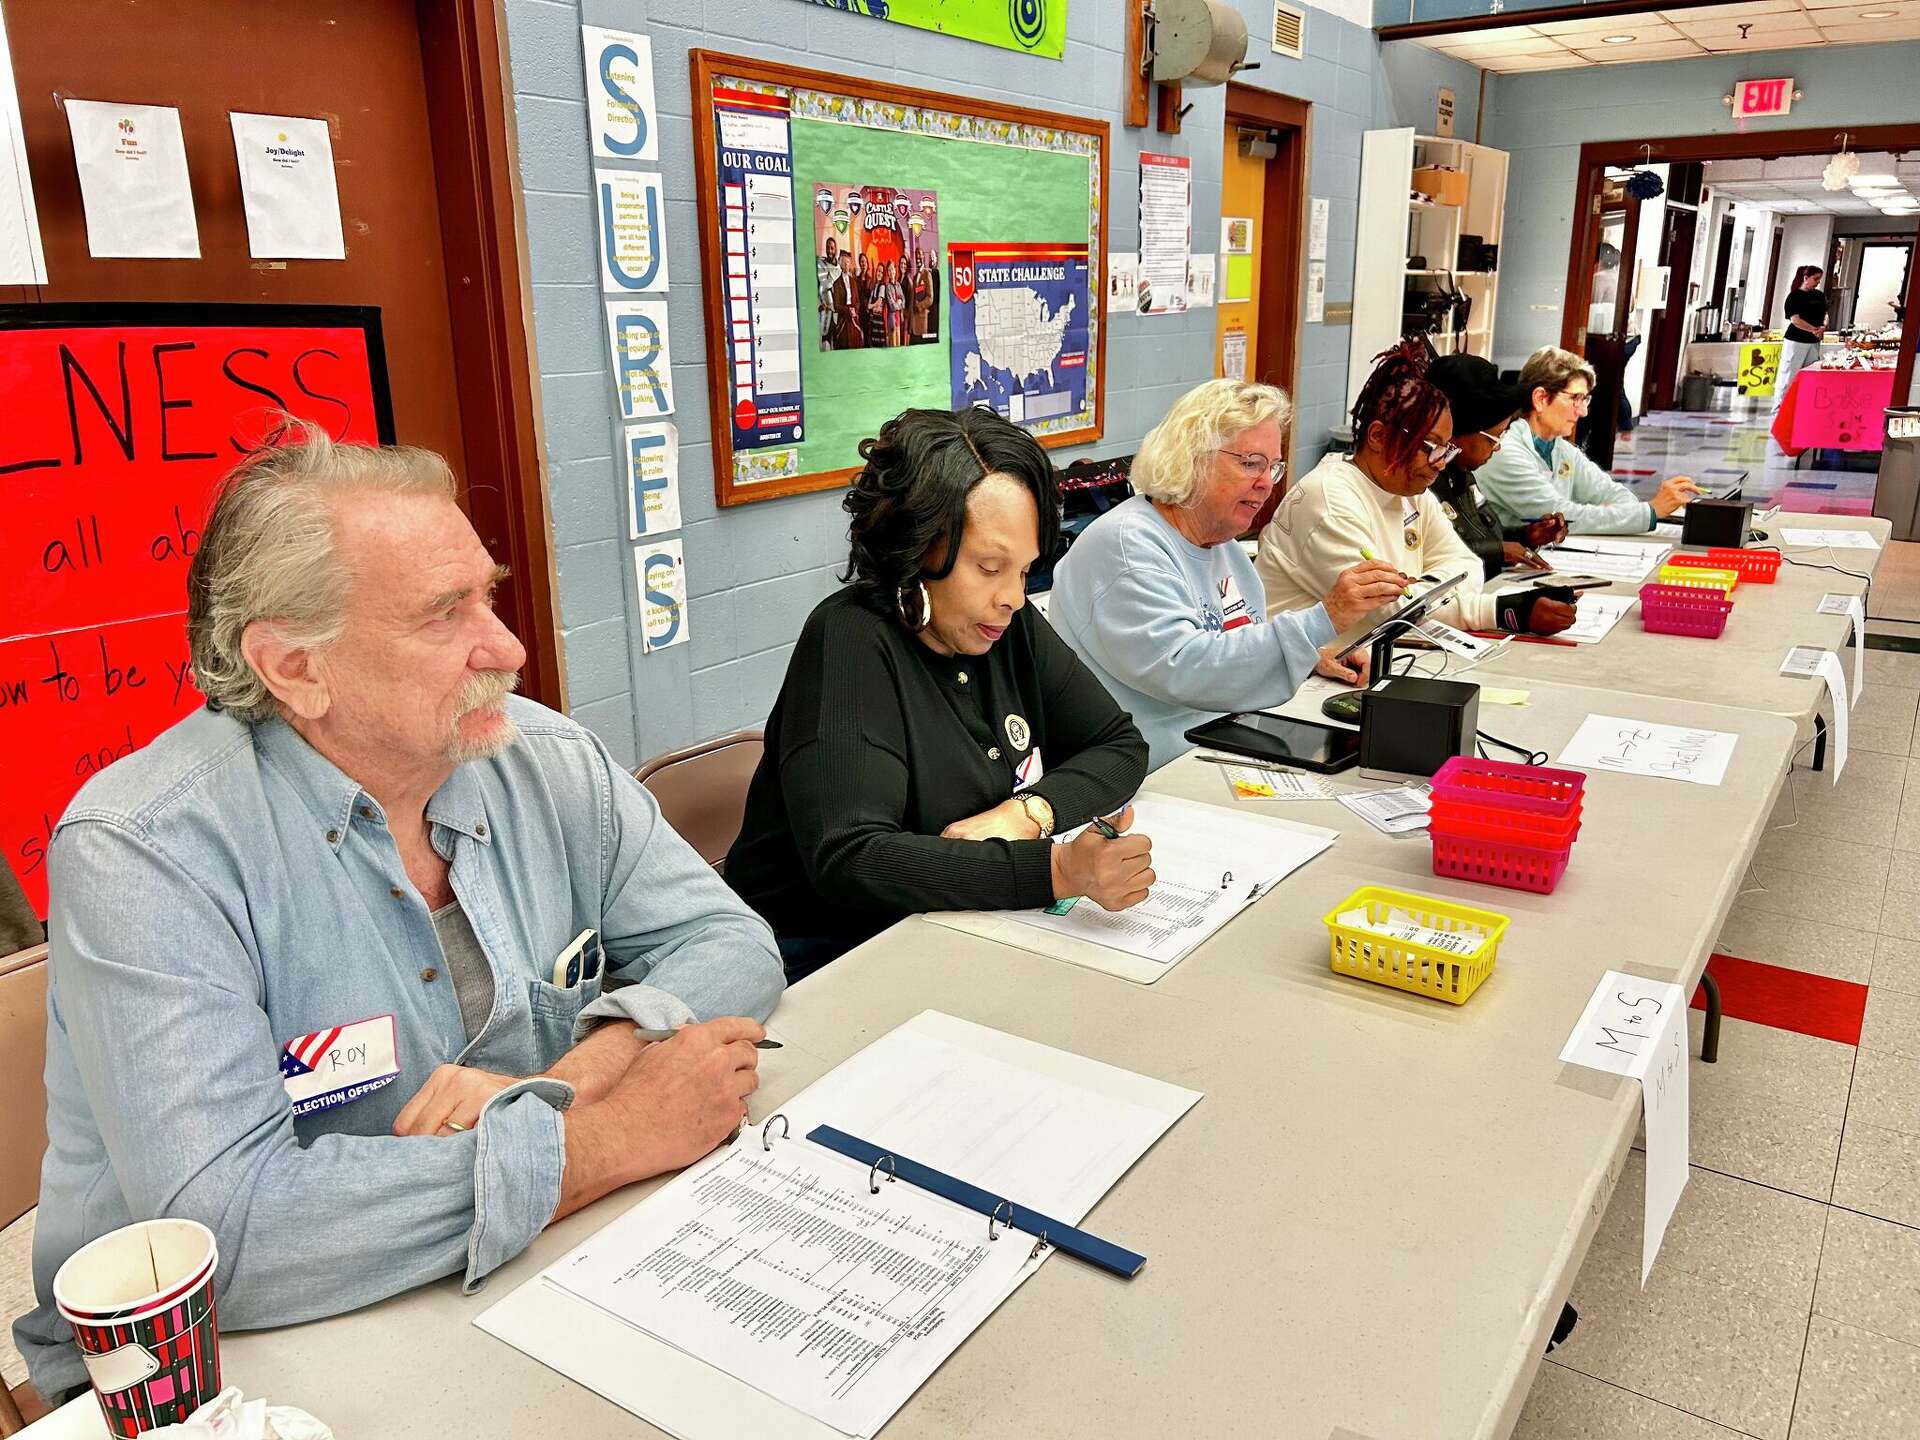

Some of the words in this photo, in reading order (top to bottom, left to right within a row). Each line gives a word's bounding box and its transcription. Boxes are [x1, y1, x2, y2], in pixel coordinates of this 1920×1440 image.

[599, 44, 647, 155] S
[1743, 80, 1786, 113] EXIT
[723, 151, 752, 169] OUR
[755, 155, 790, 172] GOAL
[864, 212, 897, 231] QUEST
[866, 202, 894, 215] CASTLE
[602, 183, 660, 289] U
[955, 267, 972, 287] 50
[978, 268, 1010, 283] STATE
[1011, 267, 1065, 282] CHALLENGE
[616, 315, 668, 415] R
[1751, 347, 1781, 367] Bak
[0, 341, 352, 475] NESS
[632, 435, 667, 533] F
[43, 514, 103, 573] all
[645, 554, 680, 647] S
[0, 684, 28, 705] ow
[42, 641, 80, 702] to
[100, 635, 146, 696] be
[75, 725, 137, 777] and
[1617, 991, 1662, 1015] S
[1624, 1015, 1642, 1025] to
[1595, 1026, 1650, 1056] M
[329, 1043, 366, 1072] ROY
[292, 1090, 346, 1115] ELECTION
